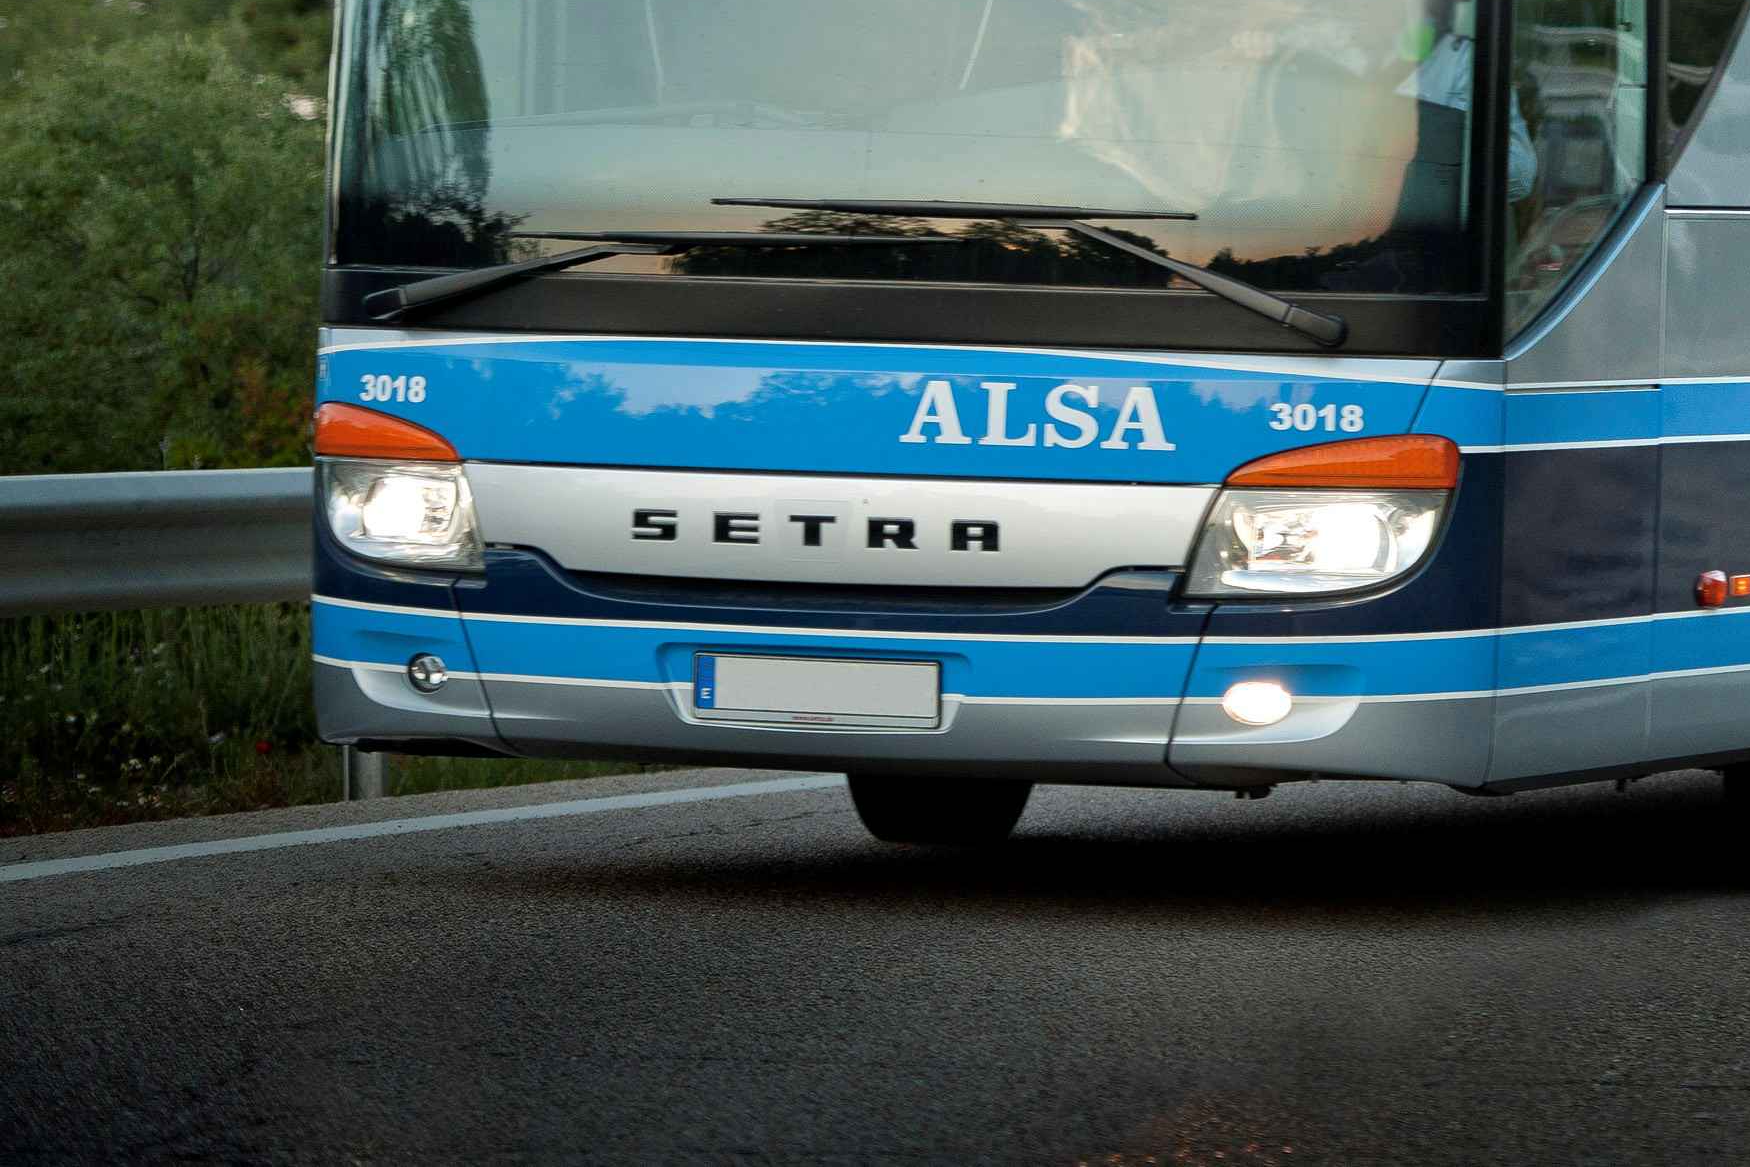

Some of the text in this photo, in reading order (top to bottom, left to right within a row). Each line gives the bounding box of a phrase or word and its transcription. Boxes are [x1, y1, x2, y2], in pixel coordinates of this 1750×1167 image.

[359, 374, 426, 403] 3018
[899, 380, 1176, 451] ALSA
[1268, 402, 1364, 433] 3018
[631, 508, 1000, 552] SETRA
